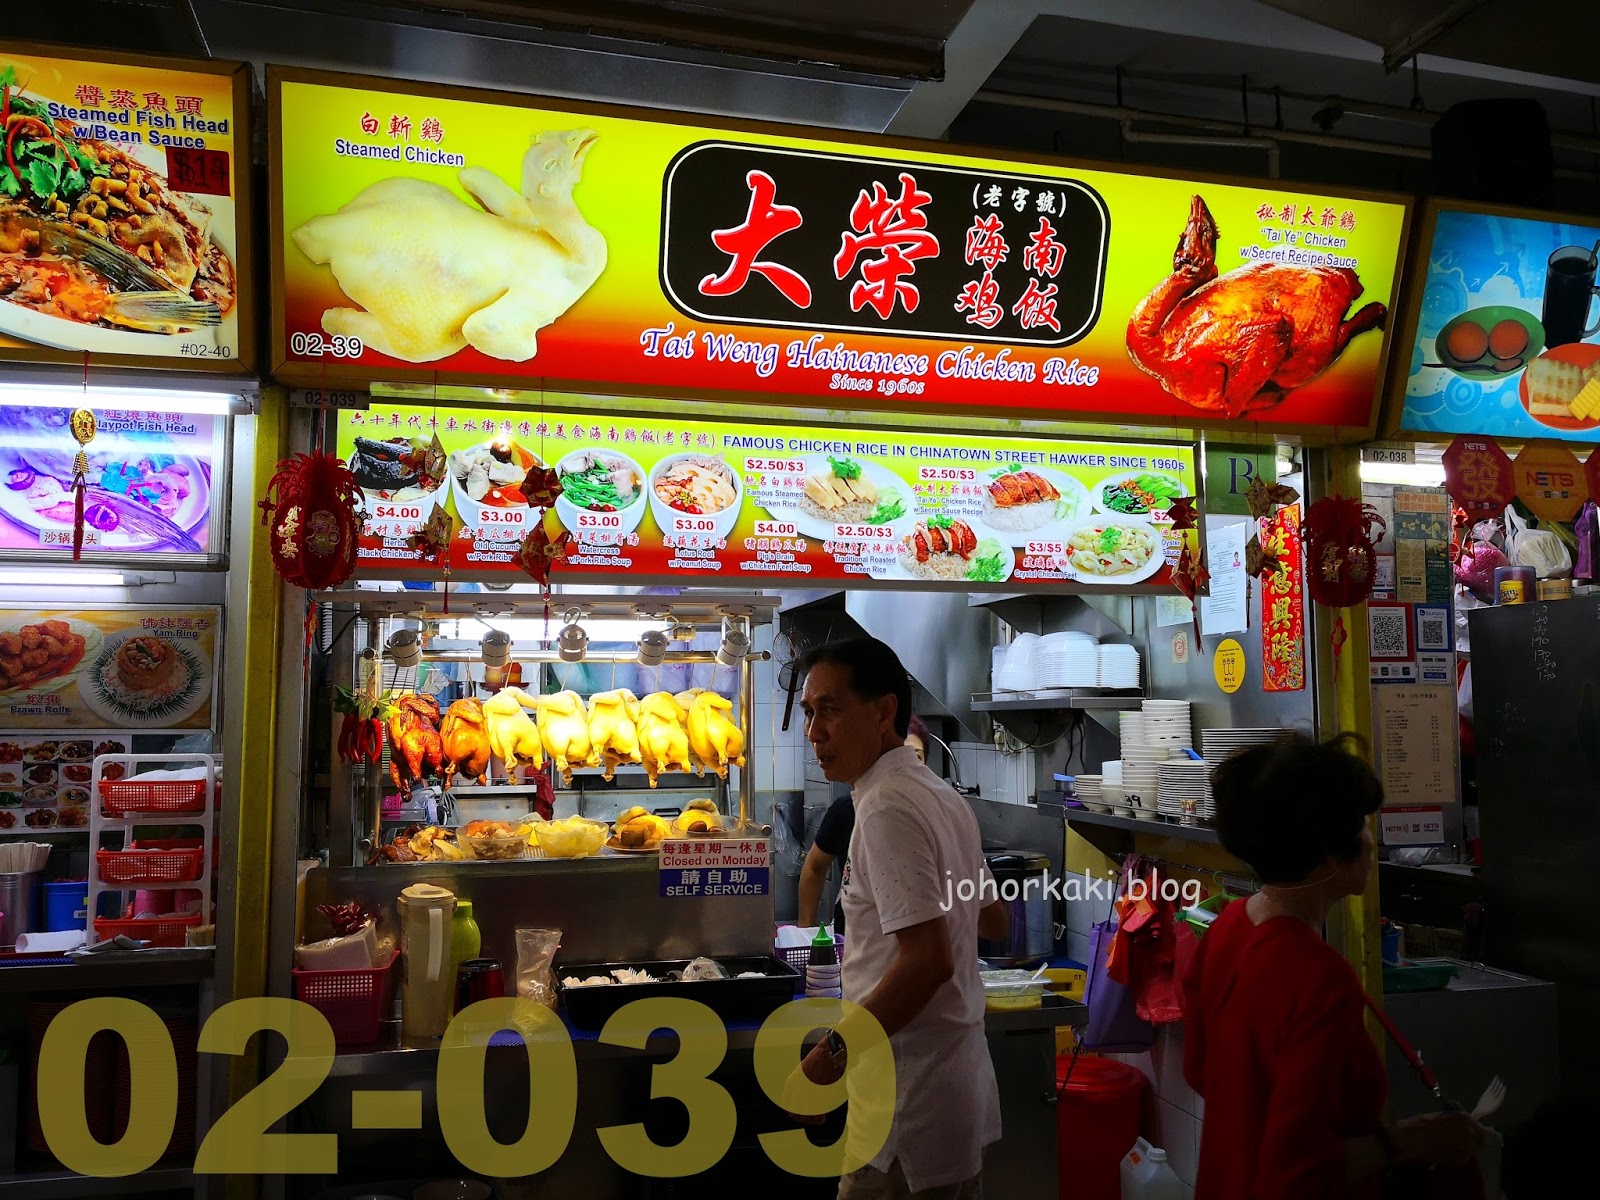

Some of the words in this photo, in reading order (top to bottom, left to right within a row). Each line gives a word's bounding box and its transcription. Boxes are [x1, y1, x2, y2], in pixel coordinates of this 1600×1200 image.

[48, 103, 129, 124] Steamed
[136, 111, 175, 128] Fish
[183, 116, 229, 134] Head
[73, 125, 141, 143] w/Bean
[148, 131, 205, 149] Sauce
[335, 139, 400, 160] Steamed
[405, 146, 464, 166] Chicken
[966, 213, 1067, 278] 海南
[1305, 232, 1346, 249] Chicken
[1240, 246, 1285, 261] w/Secret
[1289, 249, 1323, 266] Recipe
[1326, 253, 1358, 268] Sauce
[180, 343, 231, 358] #02-40
[291, 332, 363, 358] 02-39
[640, 323, 694, 358] Tai
[702, 333, 778, 377] Weng
[786, 334, 928, 375] Hainanese
[935, 346, 1035, 382] Chicken
[1043, 358, 1100, 387] Rice
[830, 374, 873, 391] Since
[878, 378, 925, 398] 1960s
[305, 391, 356, 407] 02-039
[95, 420, 136, 432] laypot
[138, 421, 162, 432] Fish
[166, 423, 194, 433] Head
[1464, 442, 1487, 451] NETS
[723, 435, 784, 450] FAMOUS
[788, 439, 851, 454] CHICKEN
[856, 442, 888, 456] RICE
[892, 445, 905, 457] IN
[910, 446, 990, 461] CHINATOWN
[995, 450, 1045, 464] STREET
[1049, 453, 1106, 467] HAWKER
[1109, 456, 1147, 469] SINCE
[1151, 458, 1185, 471] 1960s
[1373, 451, 1407, 463] 02-038
[747, 459, 804, 473] $2.50/$3
[921, 468, 975, 481] $2.50/$3
[1526, 471, 1574, 487] NETS
[747, 489, 773, 497] Famous
[775, 490, 804, 498] Steamed
[754, 499, 780, 507] Chicken
[782, 500, 797, 508] Rice
[968, 498, 982, 506] Rice
[376, 507, 420, 519] $4.00
[481, 511, 523, 523] $3.00
[942, 507, 961, 515] Sauce
[962, 508, 984, 516] Recipe
[579, 515, 619, 527] $3.00
[676, 519, 714, 531] $3.00
[758, 523, 795, 534] $4.00
[837, 526, 892, 538] $2.50/$3
[44, 532, 97, 544] 沙锅头
[384, 539, 408, 547] Herba
[568, 531, 640, 547] 洋菜排骨湯
[474, 542, 488, 550] Old
[490, 542, 521, 551] Cucumb
[579, 546, 620, 555] Watercress
[1029, 542, 1062, 553] $3/$5
[357, 549, 380, 558] Black
[381, 550, 414, 558] Chicken
[495, 553, 512, 561] Ribs
[675, 550, 696, 558] Lotus
[697, 550, 714, 558] Root
[776, 553, 794, 561] Brain
[834, 555, 868, 563] Traditional
[870, 556, 896, 564] Roasted
[594, 557, 611, 565] Ribs
[612, 558, 631, 567] Soup
[702, 560, 721, 570] Soup
[778, 563, 792, 571] Feet
[793, 564, 811, 573] Soup
[845, 565, 868, 573] Chicken
[870, 566, 886, 574] Rice
[1014, 569, 1037, 578] Crystal
[1037, 570, 1063, 578] Chicken
[176, 630, 198, 640] Ring
[11, 706, 41, 715] Prawn
[45, 706, 71, 715] Rolls
[1125, 795, 1142, 807] 39
[662, 842, 768, 855] 每逢星期一休息
[663, 856, 702, 866] Closed
[705, 857, 719, 865] on
[722, 855, 766, 867] Monday
[681, 869, 748, 885] 請自助
[666, 886, 700, 896] SELF
[704, 884, 762, 895] SERVICE
